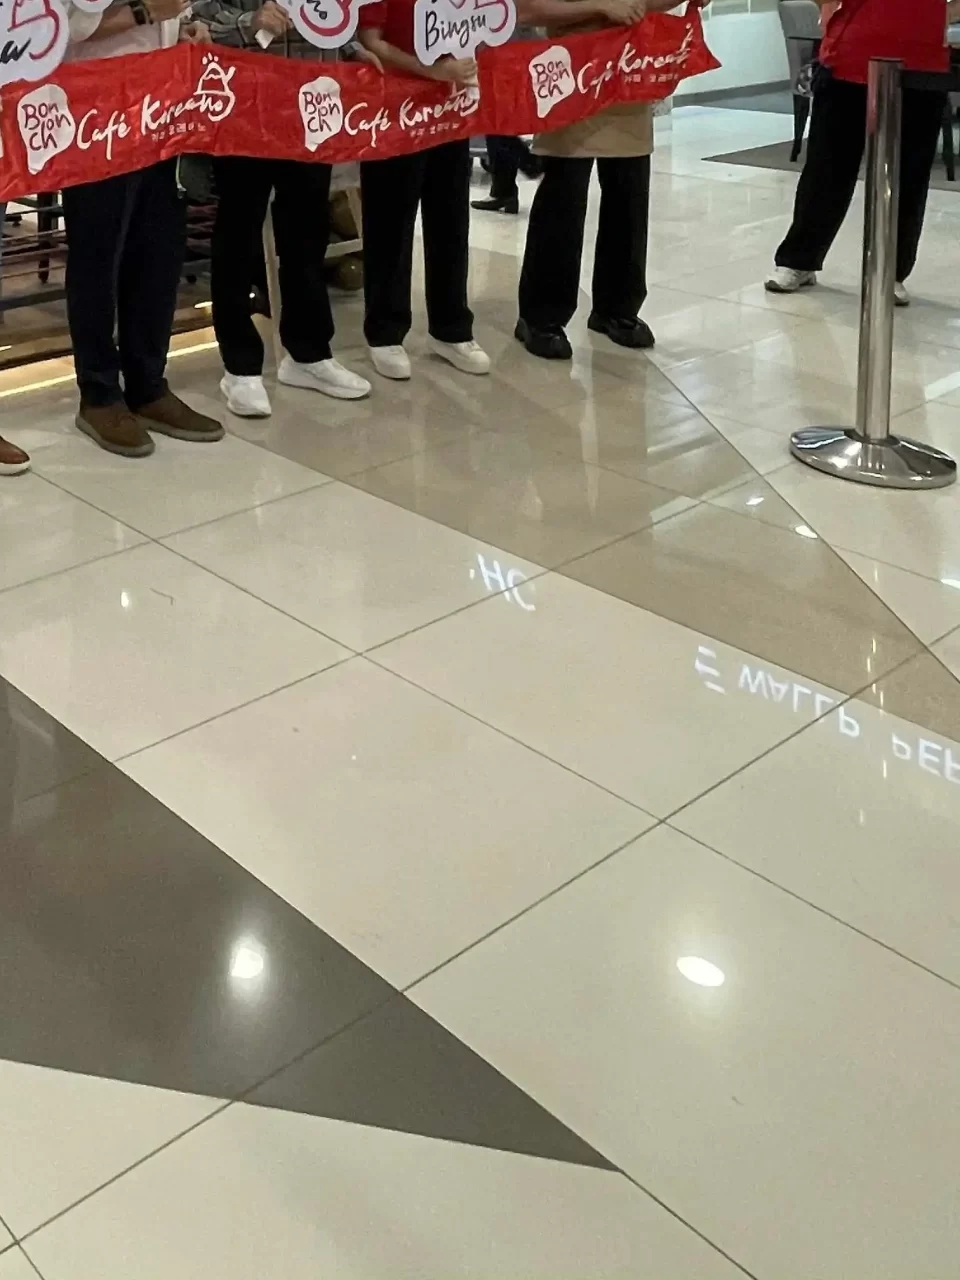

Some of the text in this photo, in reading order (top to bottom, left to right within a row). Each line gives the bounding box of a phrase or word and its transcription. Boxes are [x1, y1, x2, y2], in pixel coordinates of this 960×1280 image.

[426, 10, 487, 51] Bingsu
[618, 42, 690, 74] Korea
[77, 93, 225, 160] Café Koreano
[344, 102, 392, 148] Café
